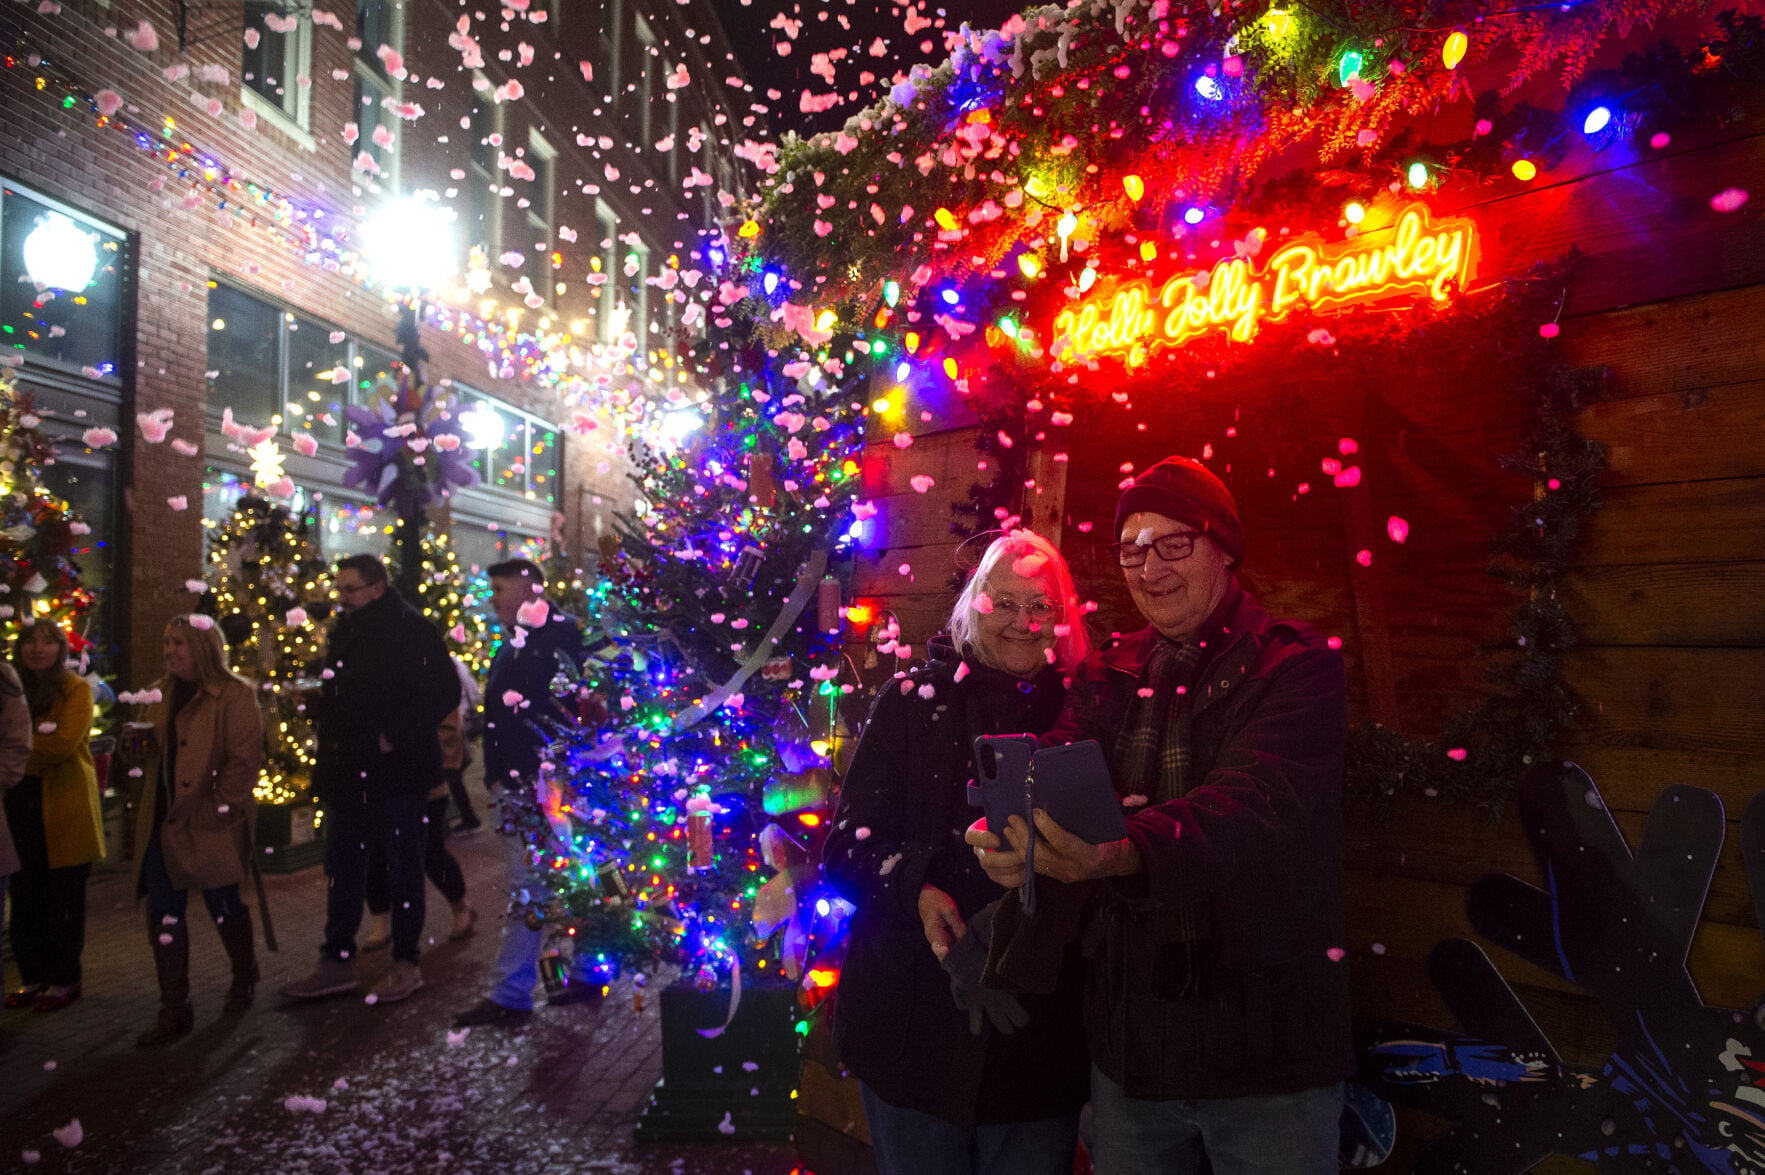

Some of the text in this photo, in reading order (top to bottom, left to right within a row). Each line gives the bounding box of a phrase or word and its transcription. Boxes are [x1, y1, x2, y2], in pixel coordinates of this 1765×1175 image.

[1056, 211, 1463, 366] Holly Jolly Brawley
